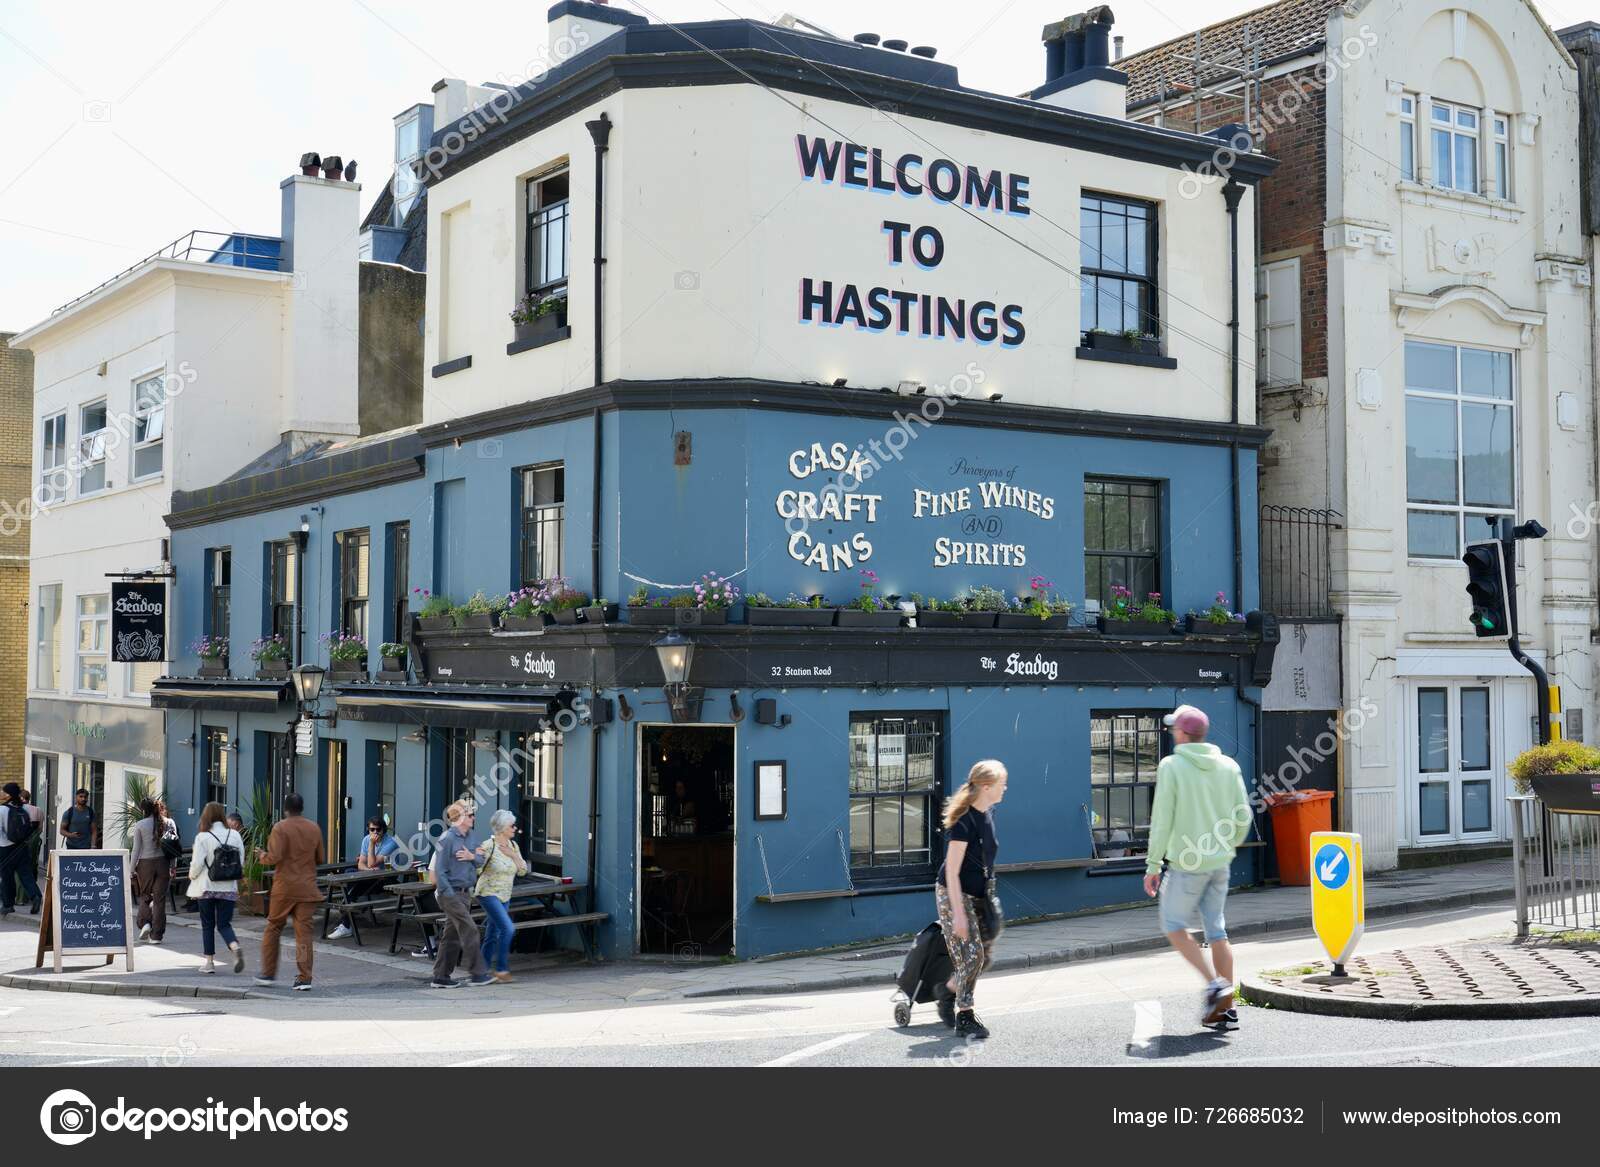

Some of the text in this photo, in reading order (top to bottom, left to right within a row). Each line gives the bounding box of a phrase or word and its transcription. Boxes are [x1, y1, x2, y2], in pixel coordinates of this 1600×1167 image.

[796, 134, 1030, 217] WELCOME
[881, 220, 944, 271] TO
[799, 277, 1026, 349] HASTINGS
[789, 442, 871, 483] CASK
[949, 457, 1019, 482] Purveyors of
[776, 490, 882, 522] CRAFT
[913, 481, 1054, 520] FINE WINES
[962, 514, 1003, 538] AND
[788, 531, 873, 571] CANS
[934, 537, 1026, 567] SPIRITS
[114, 597, 162, 615] Seadog
[524, 651, 556, 679] Seadog
[771, 666, 832, 676] 32 Station Road
[980, 652, 1058, 680] The Seadog
[72, 861, 87, 873] The
[62, 904, 78, 914] Good
[80, 891, 95, 900] Food
[63, 918, 85, 930] Kitchen
[86, 919, 100, 931] Open
